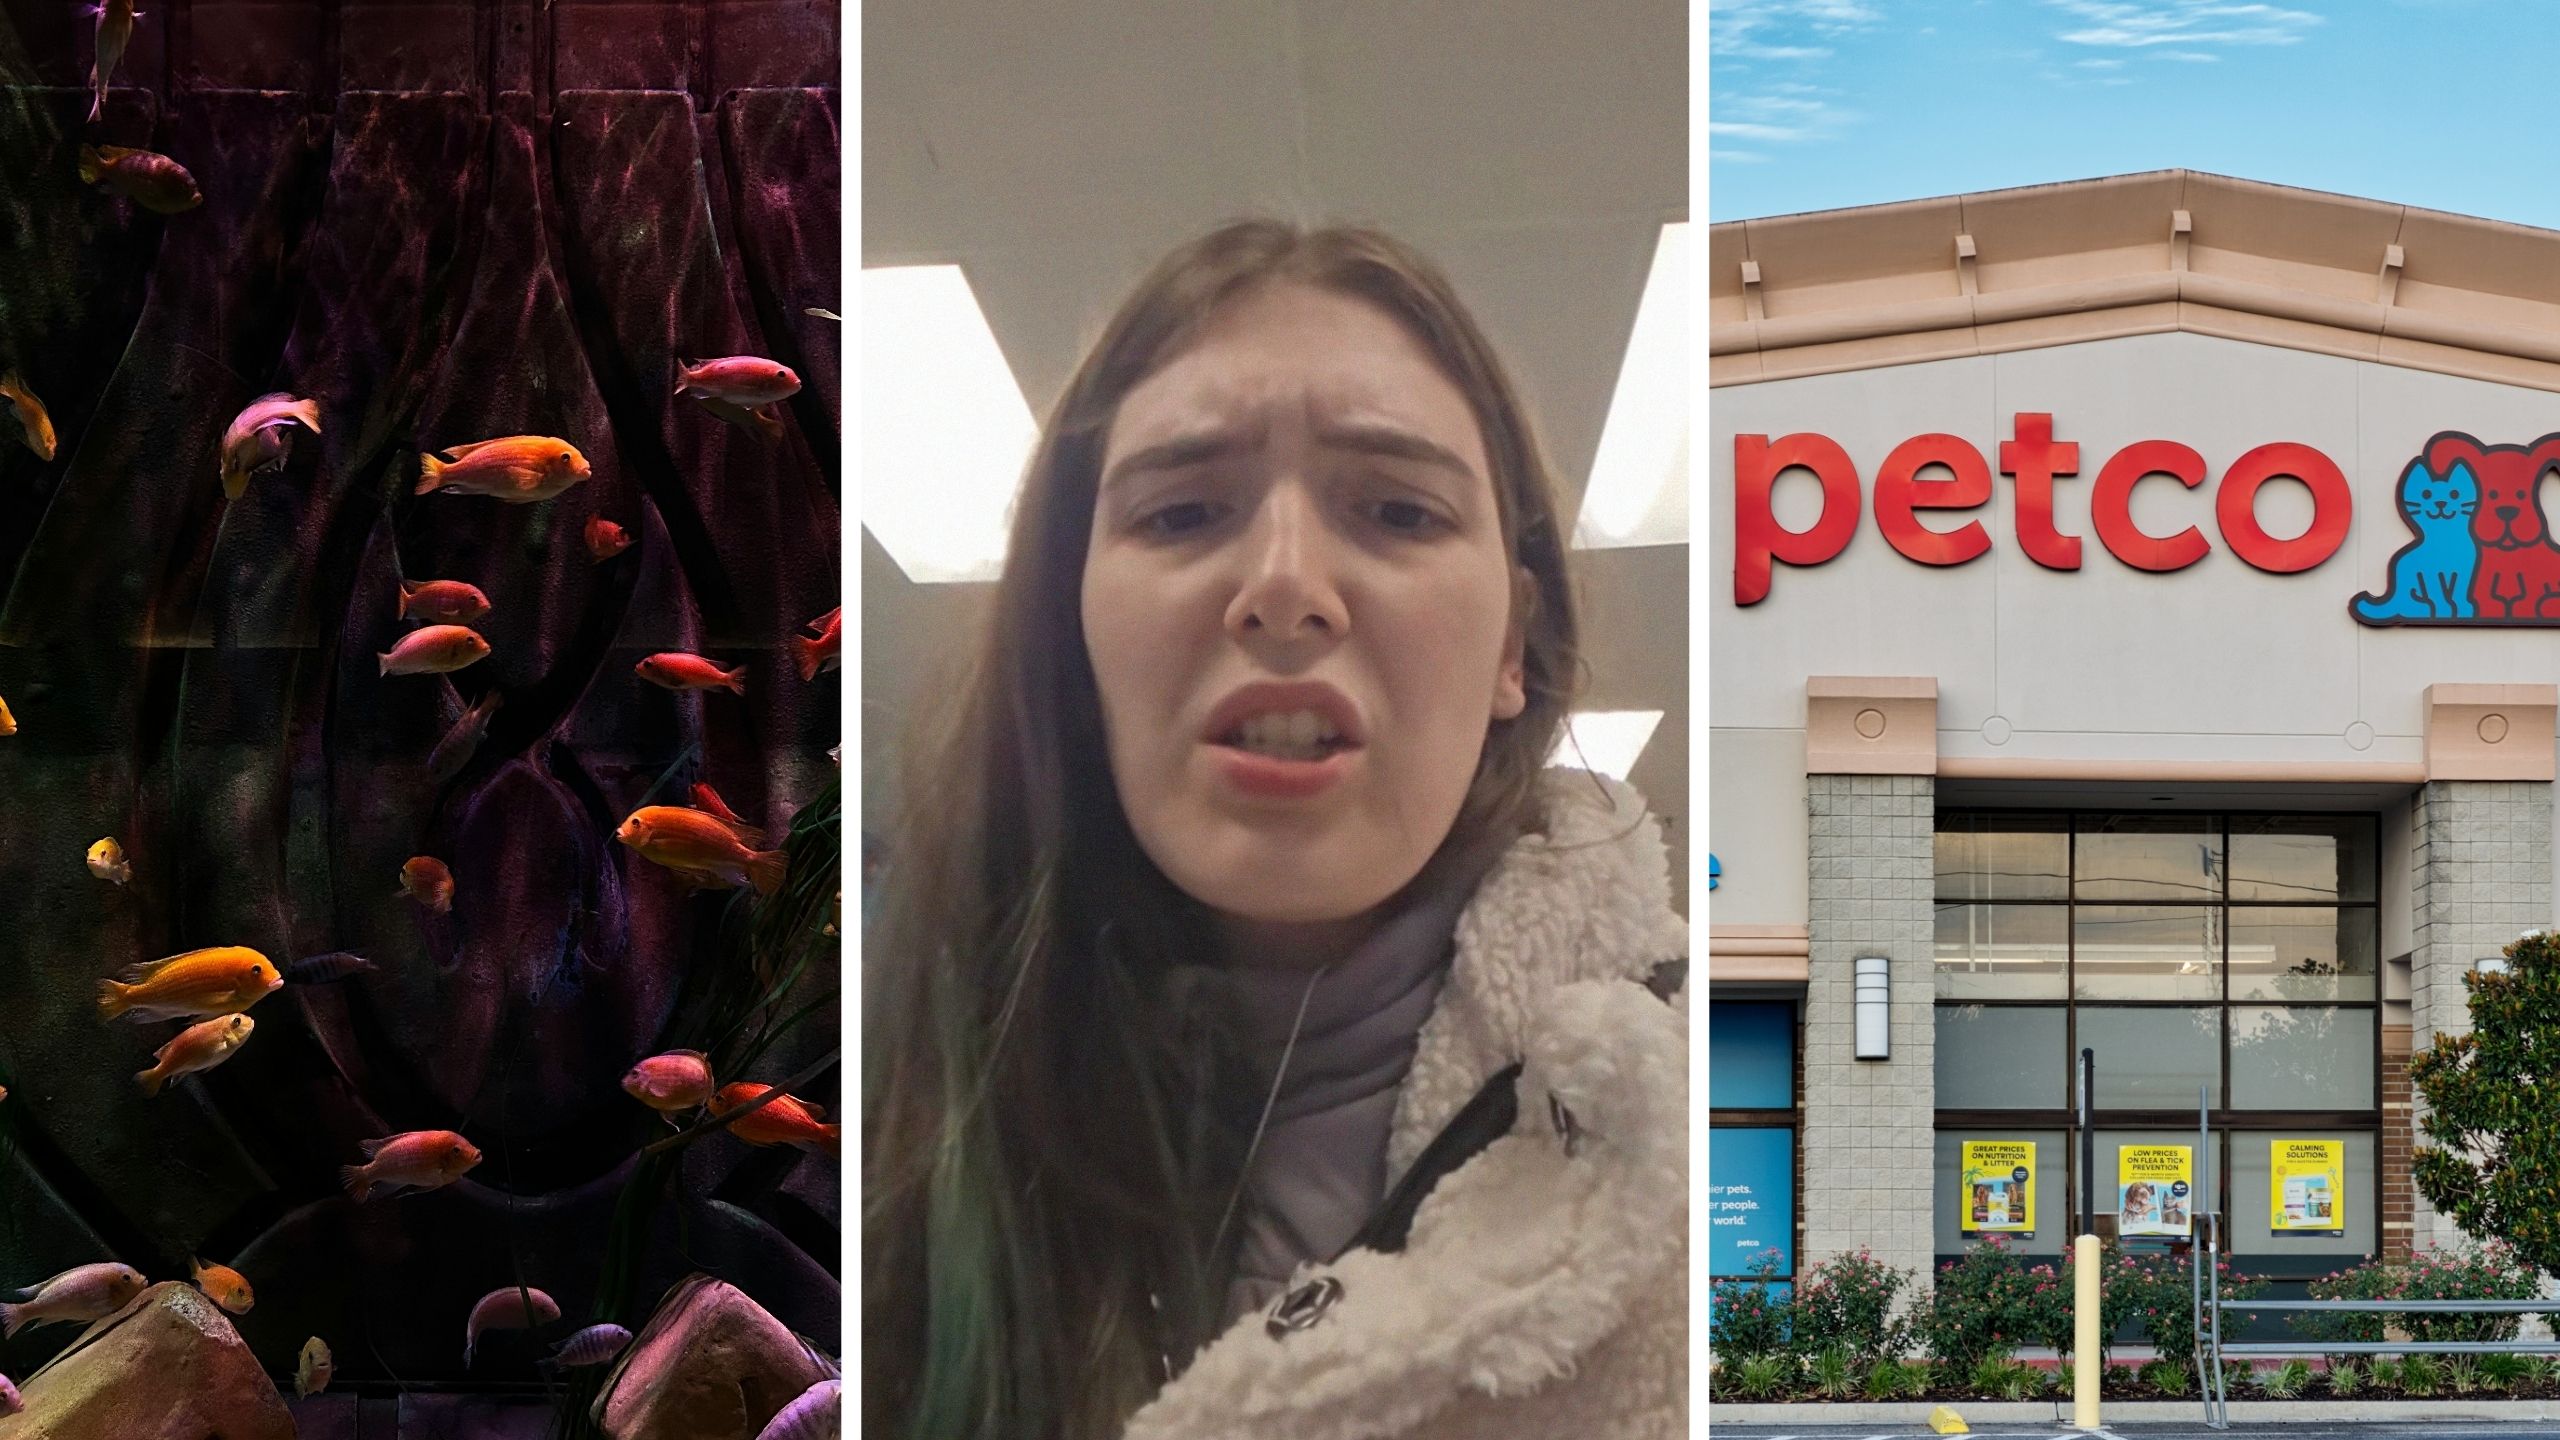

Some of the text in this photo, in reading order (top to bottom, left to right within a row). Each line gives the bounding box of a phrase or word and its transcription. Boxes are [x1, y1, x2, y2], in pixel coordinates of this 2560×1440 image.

[1735, 412, 2352, 607] petco
[1709, 1184, 1752, 1195] ier pets.
[1722, 1200, 1760, 1211] people.
